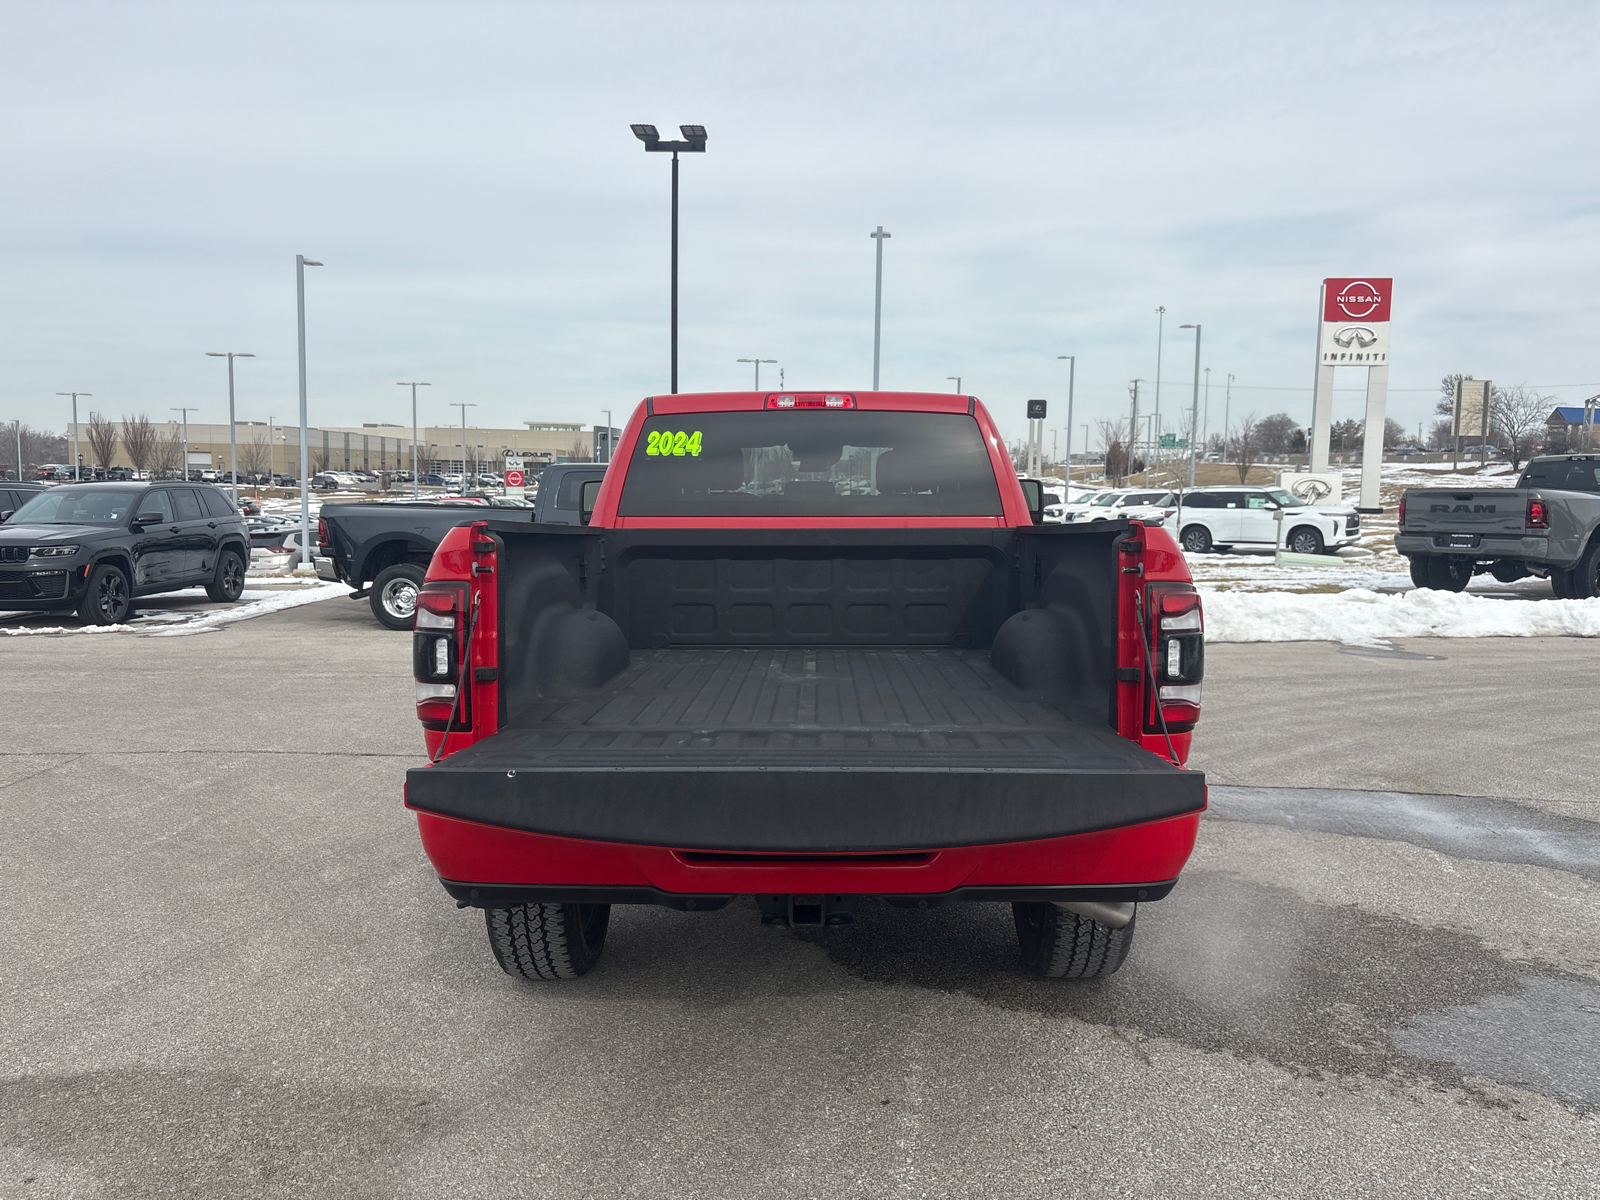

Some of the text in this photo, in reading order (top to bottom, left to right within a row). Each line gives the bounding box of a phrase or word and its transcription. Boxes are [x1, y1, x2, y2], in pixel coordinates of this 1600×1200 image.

[1323, 353, 1386, 361] INFINITI
[646, 430, 703, 457] 2024
[1429, 504, 1496, 513] RAM
